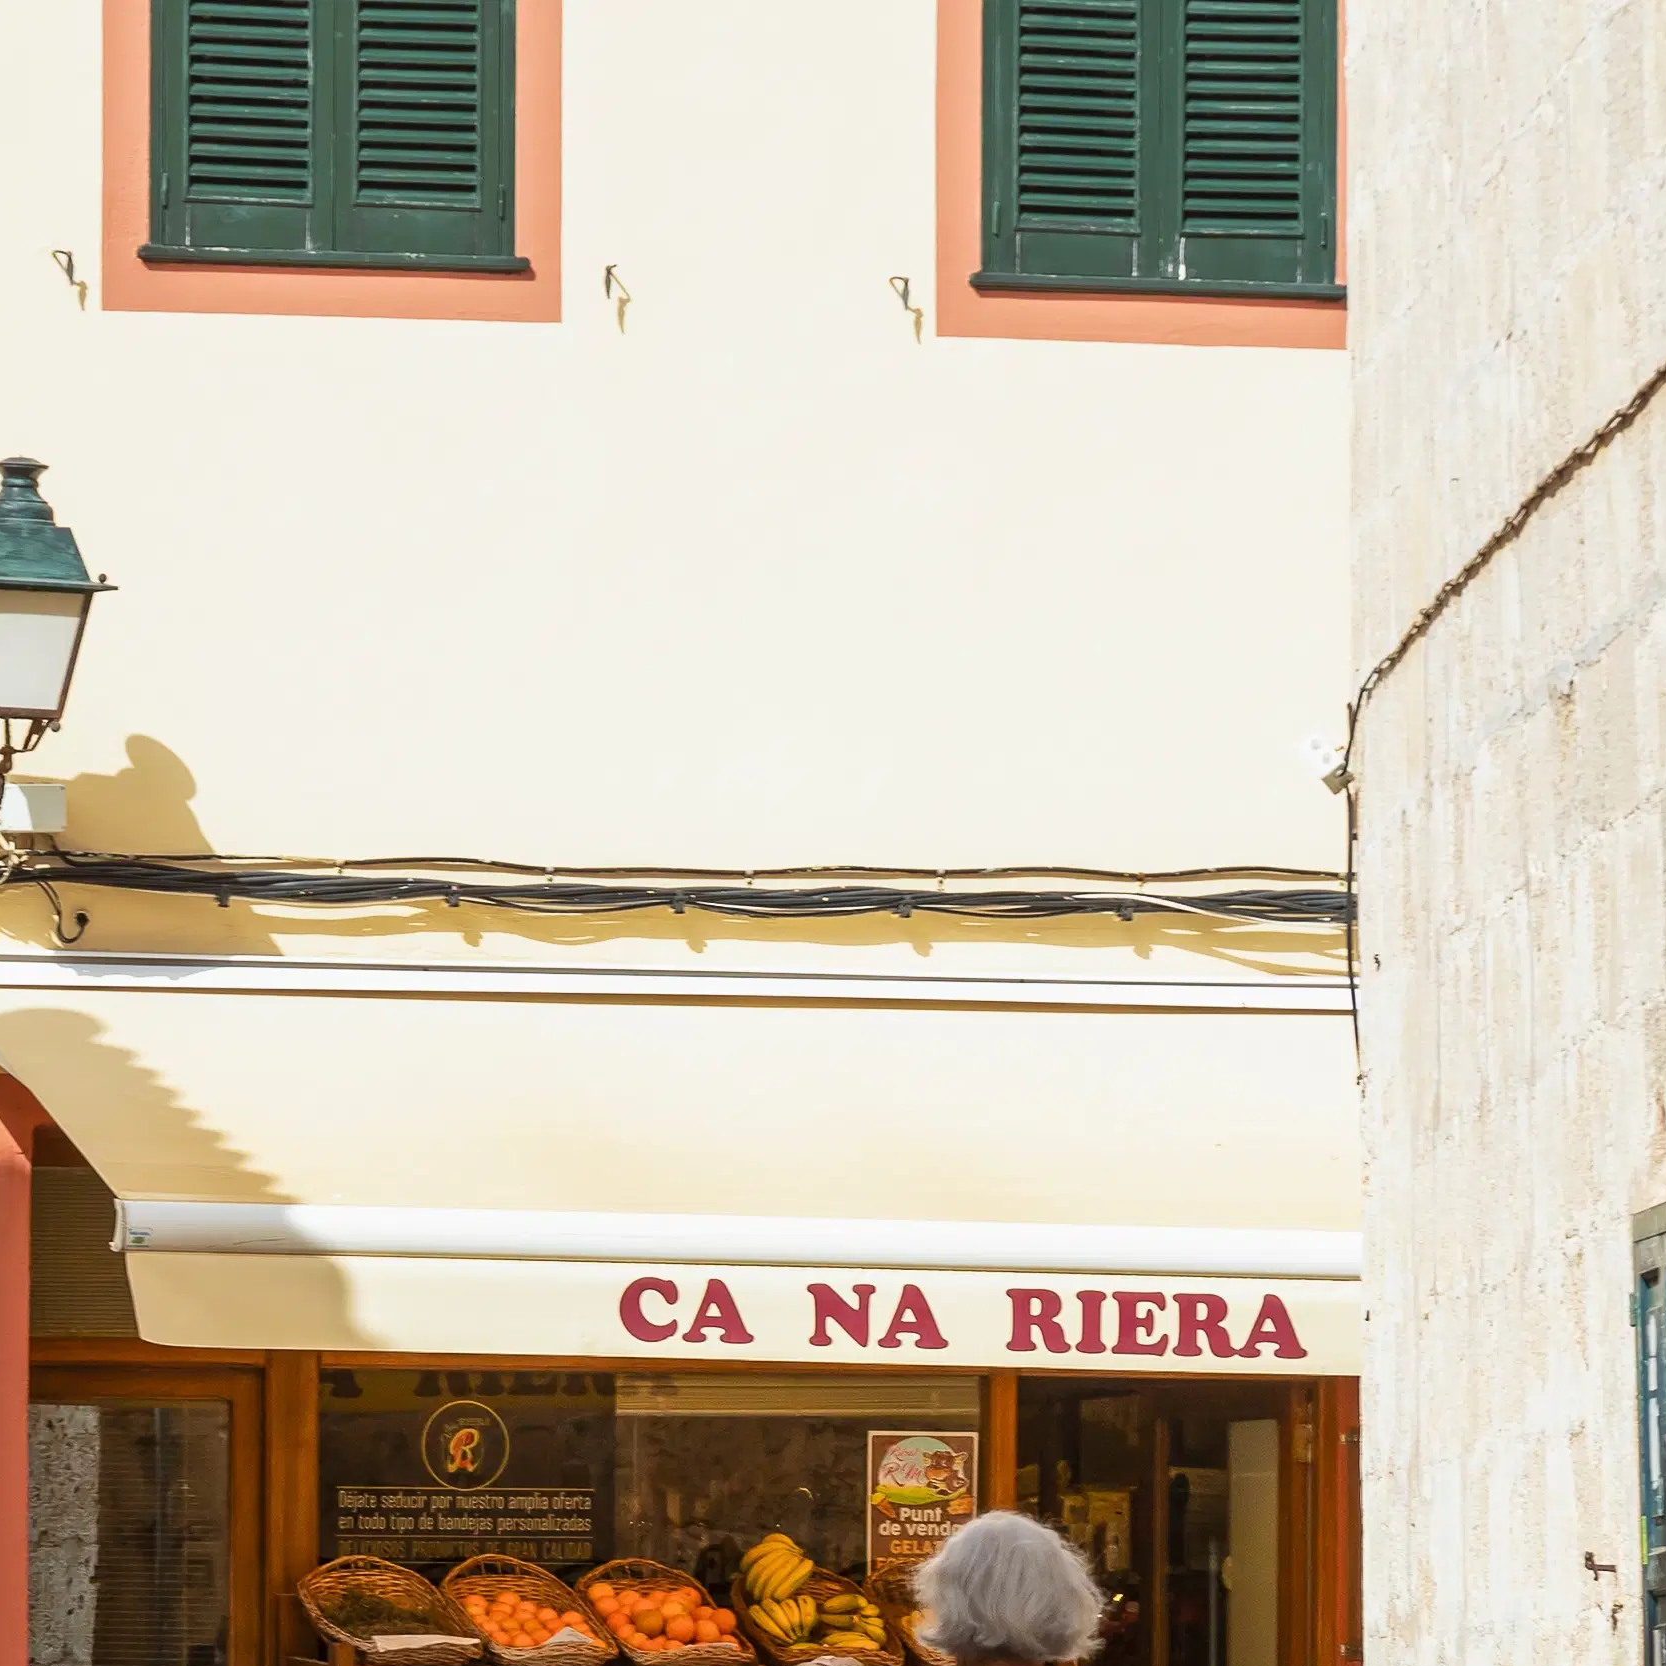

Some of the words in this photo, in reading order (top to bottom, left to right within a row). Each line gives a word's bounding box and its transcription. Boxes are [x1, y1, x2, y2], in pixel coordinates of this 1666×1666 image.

[619, 1277, 754, 1344] CA
[807, 1282, 949, 1350] NA
[1006, 1287, 1308, 1359] RIERA
[381, 1491, 427, 1509] seducir
[430, 1495, 452, 1512] por
[508, 1492, 550, 1513] amplia
[552, 1492, 592, 1510] oferta
[338, 1516, 354, 1530] en
[358, 1513, 387, 1530] todo
[389, 1513, 415, 1533] tipo
[418, 1513, 434, 1530] de
[437, 1513, 493, 1534] bandejas
[496, 1513, 592, 1534] personalizadas
[899, 1507, 943, 1522] Punt
[879, 1520, 902, 1536] de
